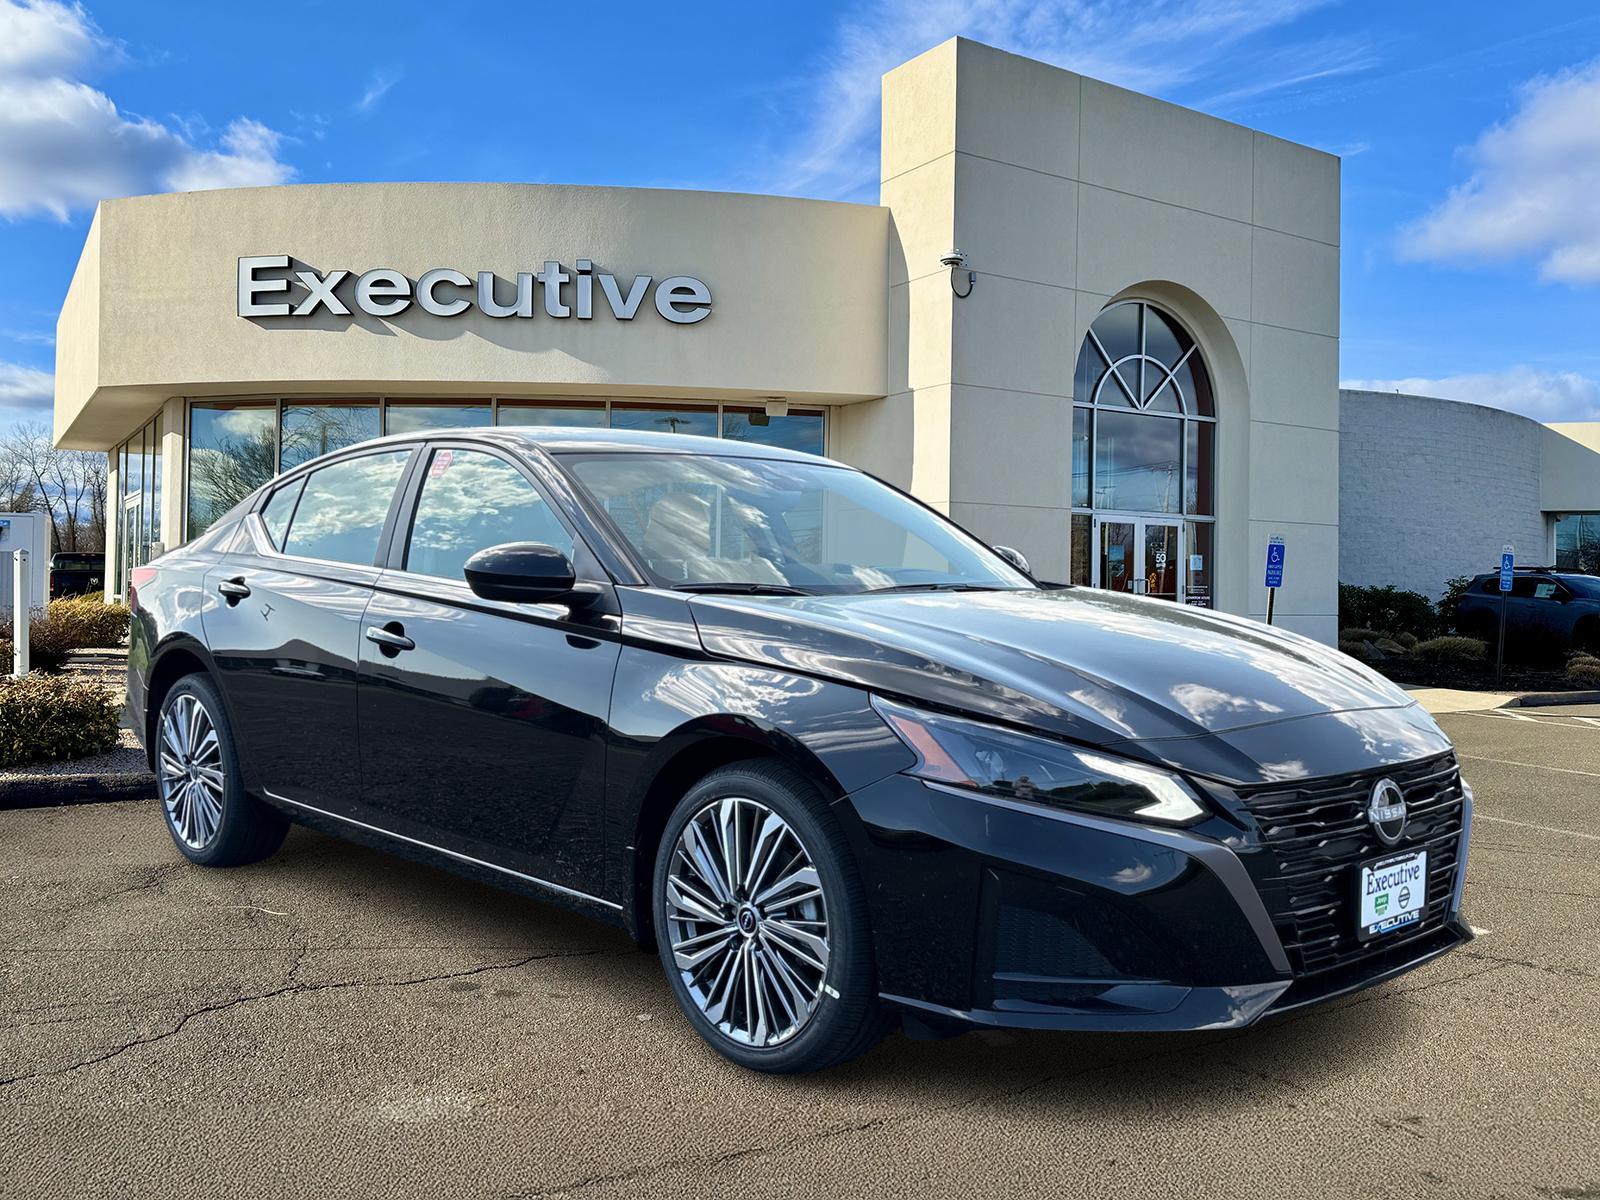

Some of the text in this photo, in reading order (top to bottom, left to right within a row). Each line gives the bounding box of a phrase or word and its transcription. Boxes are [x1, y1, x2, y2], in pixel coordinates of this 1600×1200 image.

[237, 254, 713, 325] Executive
[1366, 862, 1420, 896] Executive
[1369, 909, 1420, 935] EXECUTIVE
